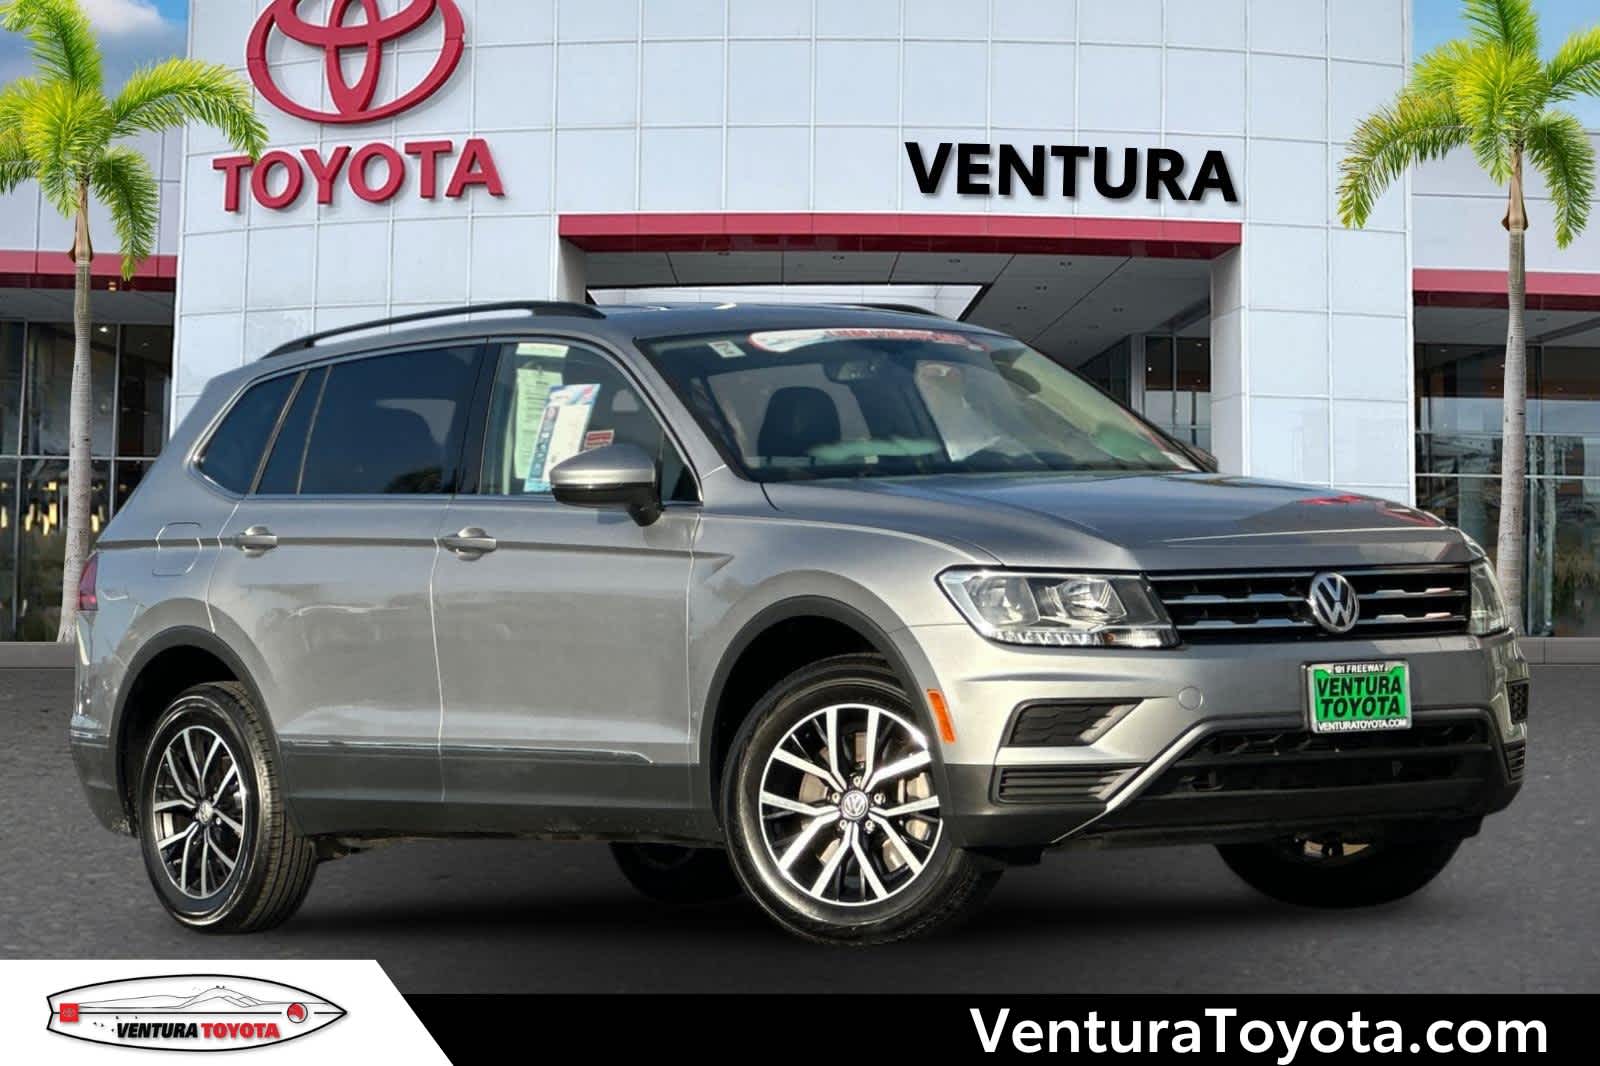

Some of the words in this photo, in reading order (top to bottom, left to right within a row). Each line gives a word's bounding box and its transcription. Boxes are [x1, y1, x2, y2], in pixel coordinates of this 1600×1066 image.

[212, 138, 505, 212] TOYOTA
[904, 141, 1238, 202] VENTURA
[1346, 664, 1385, 673] FREEWAY
[1317, 675, 1403, 698] VENTURA
[1320, 695, 1402, 718] TOYOTA
[1318, 718, 1408, 732] VENTURATOYOTA.COM
